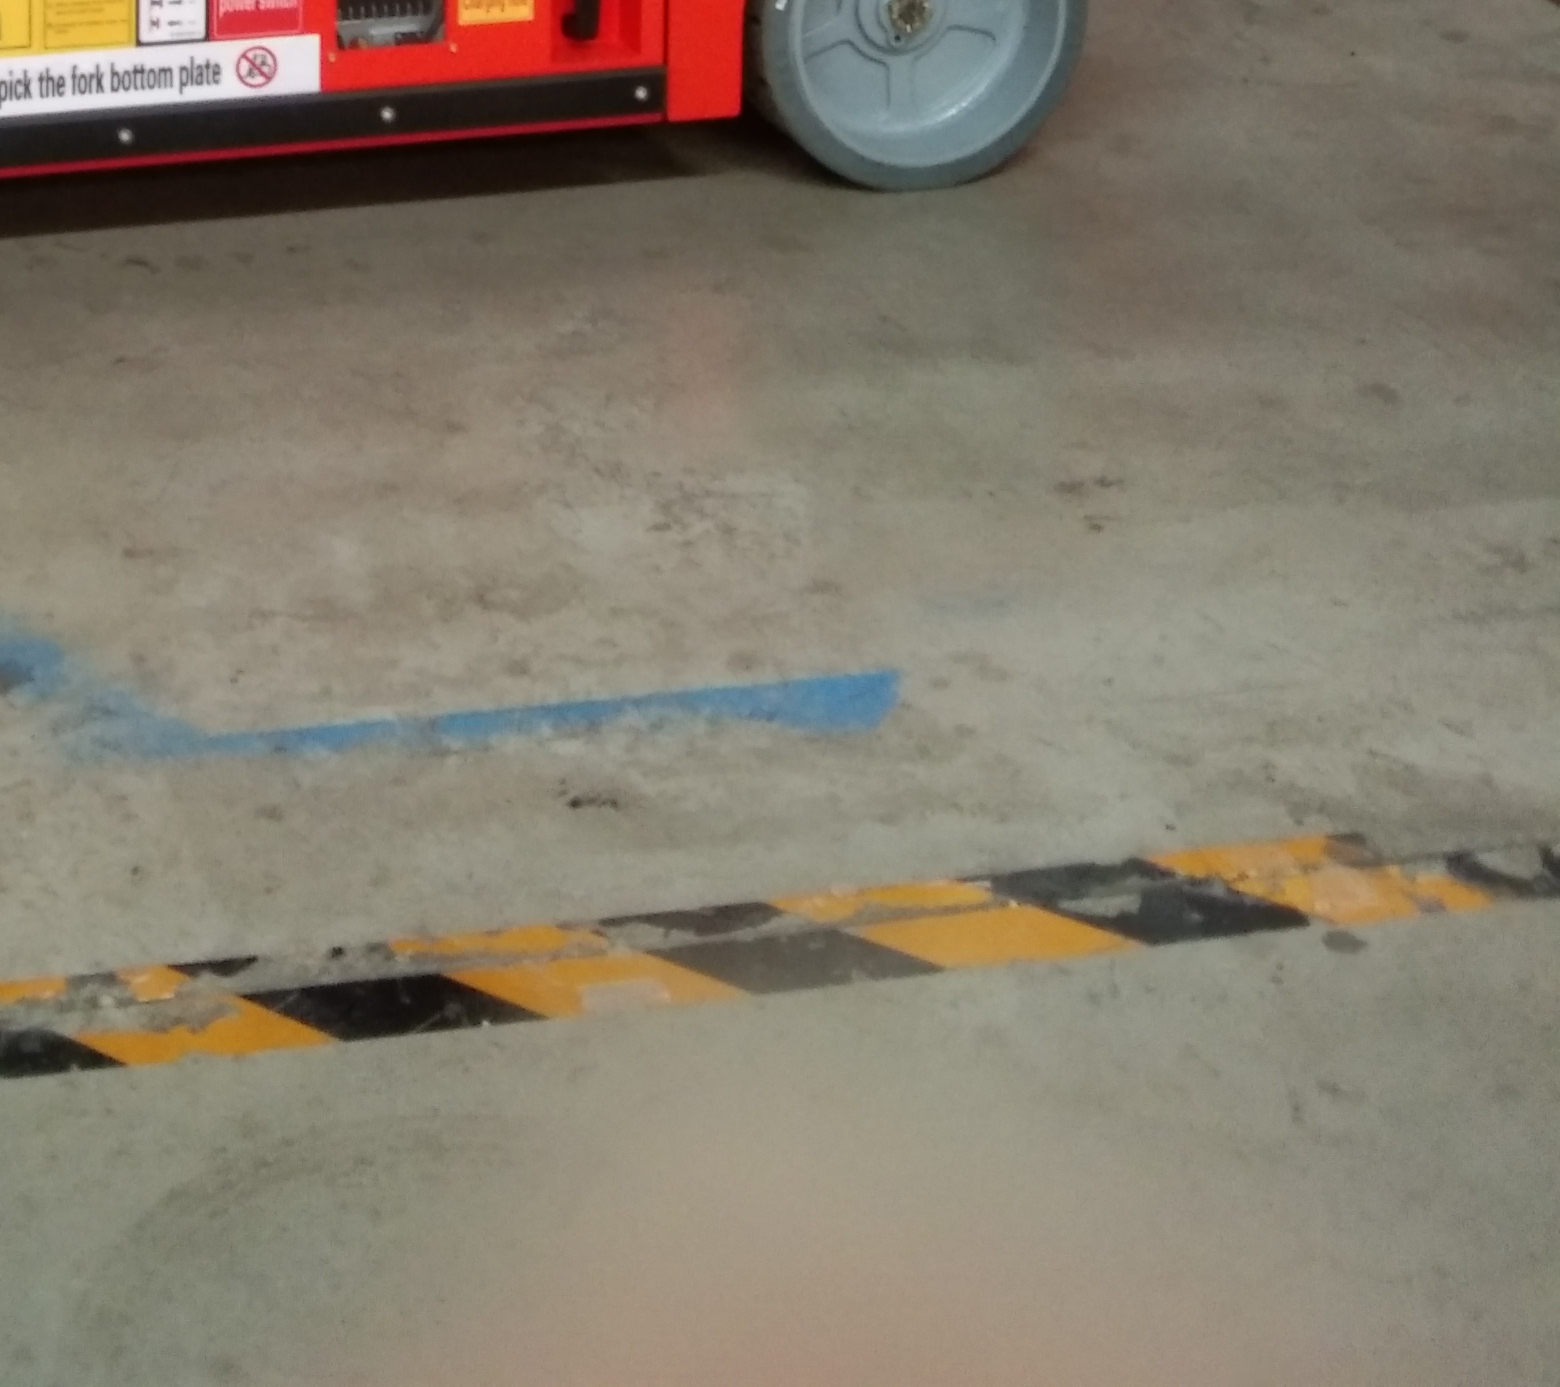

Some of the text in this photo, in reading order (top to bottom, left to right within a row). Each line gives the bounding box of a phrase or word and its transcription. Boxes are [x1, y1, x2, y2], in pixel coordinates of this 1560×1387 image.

[37, 66, 66, 100] the
[71, 63, 105, 96] fork
[110, 62, 174, 94] bottom
[178, 56, 222, 95] plate
